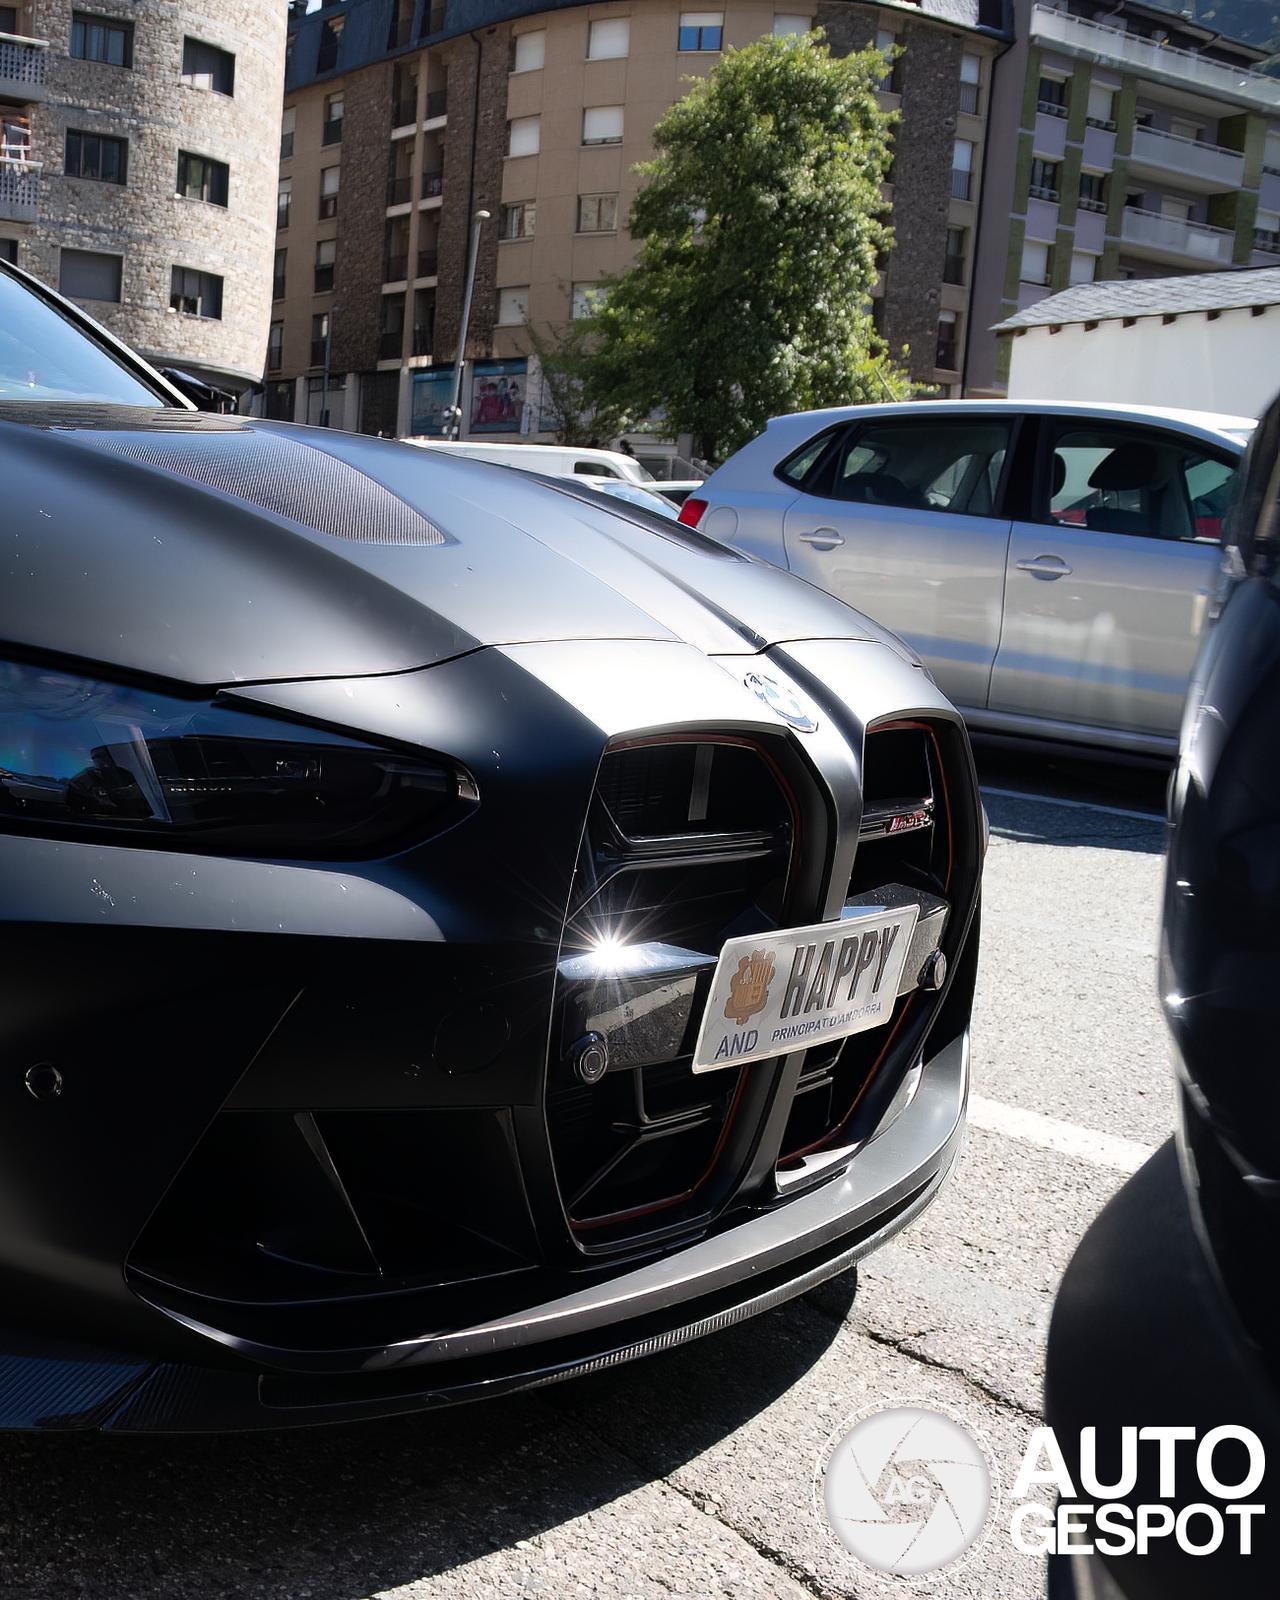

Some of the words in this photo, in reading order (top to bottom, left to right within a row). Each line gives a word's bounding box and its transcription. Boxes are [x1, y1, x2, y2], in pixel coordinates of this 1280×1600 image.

[779, 923, 901, 1019] HAPPY
[714, 1030, 759, 1060] AND
[772, 1018, 828, 1042] PRINCIPAT
